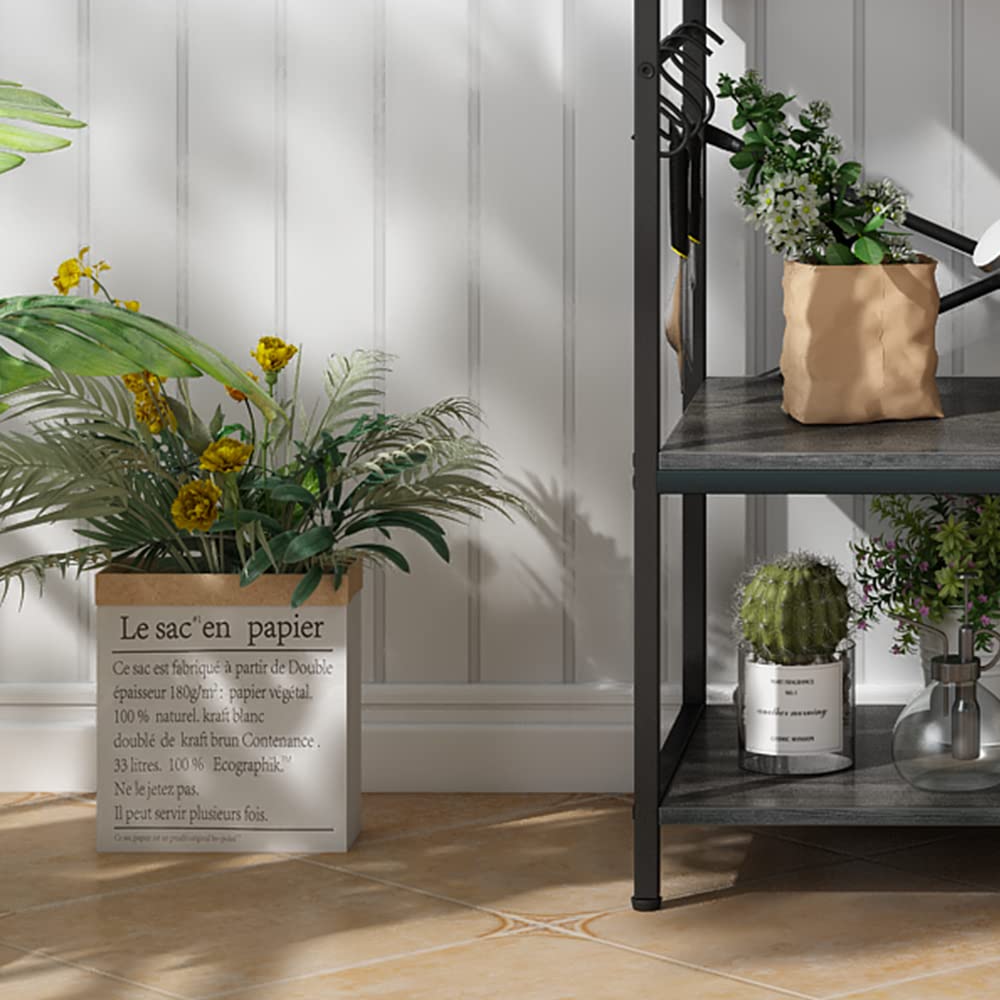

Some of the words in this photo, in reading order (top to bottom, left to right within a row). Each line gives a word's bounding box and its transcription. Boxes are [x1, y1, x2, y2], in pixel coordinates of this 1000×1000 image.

[120, 615, 149, 640] Le
[202, 620, 232, 639] en
[247, 613, 325, 647] papier
[112, 660, 130, 676] Ce
[132, 663, 151, 676] sac
[153, 663, 170, 675] est
[172, 659, 220, 680] fabriqué
[224, 660, 233, 674] à
[235, 659, 268, 679] partir
[270, 658, 286, 675] de
[288, 658, 334, 675] Double
[113, 684, 167, 704] épaisseur
[229, 684, 267, 704] papier
[114, 708, 135, 724] 100
[202, 707, 230, 723] kraft
[232, 707, 265, 723] blanc
[113, 732, 156, 748] doublé
[160, 731, 176, 748] de
[181, 731, 208, 748] kraft
[209, 731, 240, 748] brun
[113, 758, 128, 773] 33
[130, 756, 162, 773] litres.
[169, 758, 190, 773] 100
[114, 781, 133, 796] Ne
[135, 780, 146, 796] le
[146, 781, 175, 801] jetez
[176, 784, 200, 801] pas.
[114, 804, 123, 820] Il
[125, 807, 152, 824] peut
[154, 804, 187, 821] servir
[189, 804, 242, 825] plusieurs
[244, 804, 269, 822] fois.
